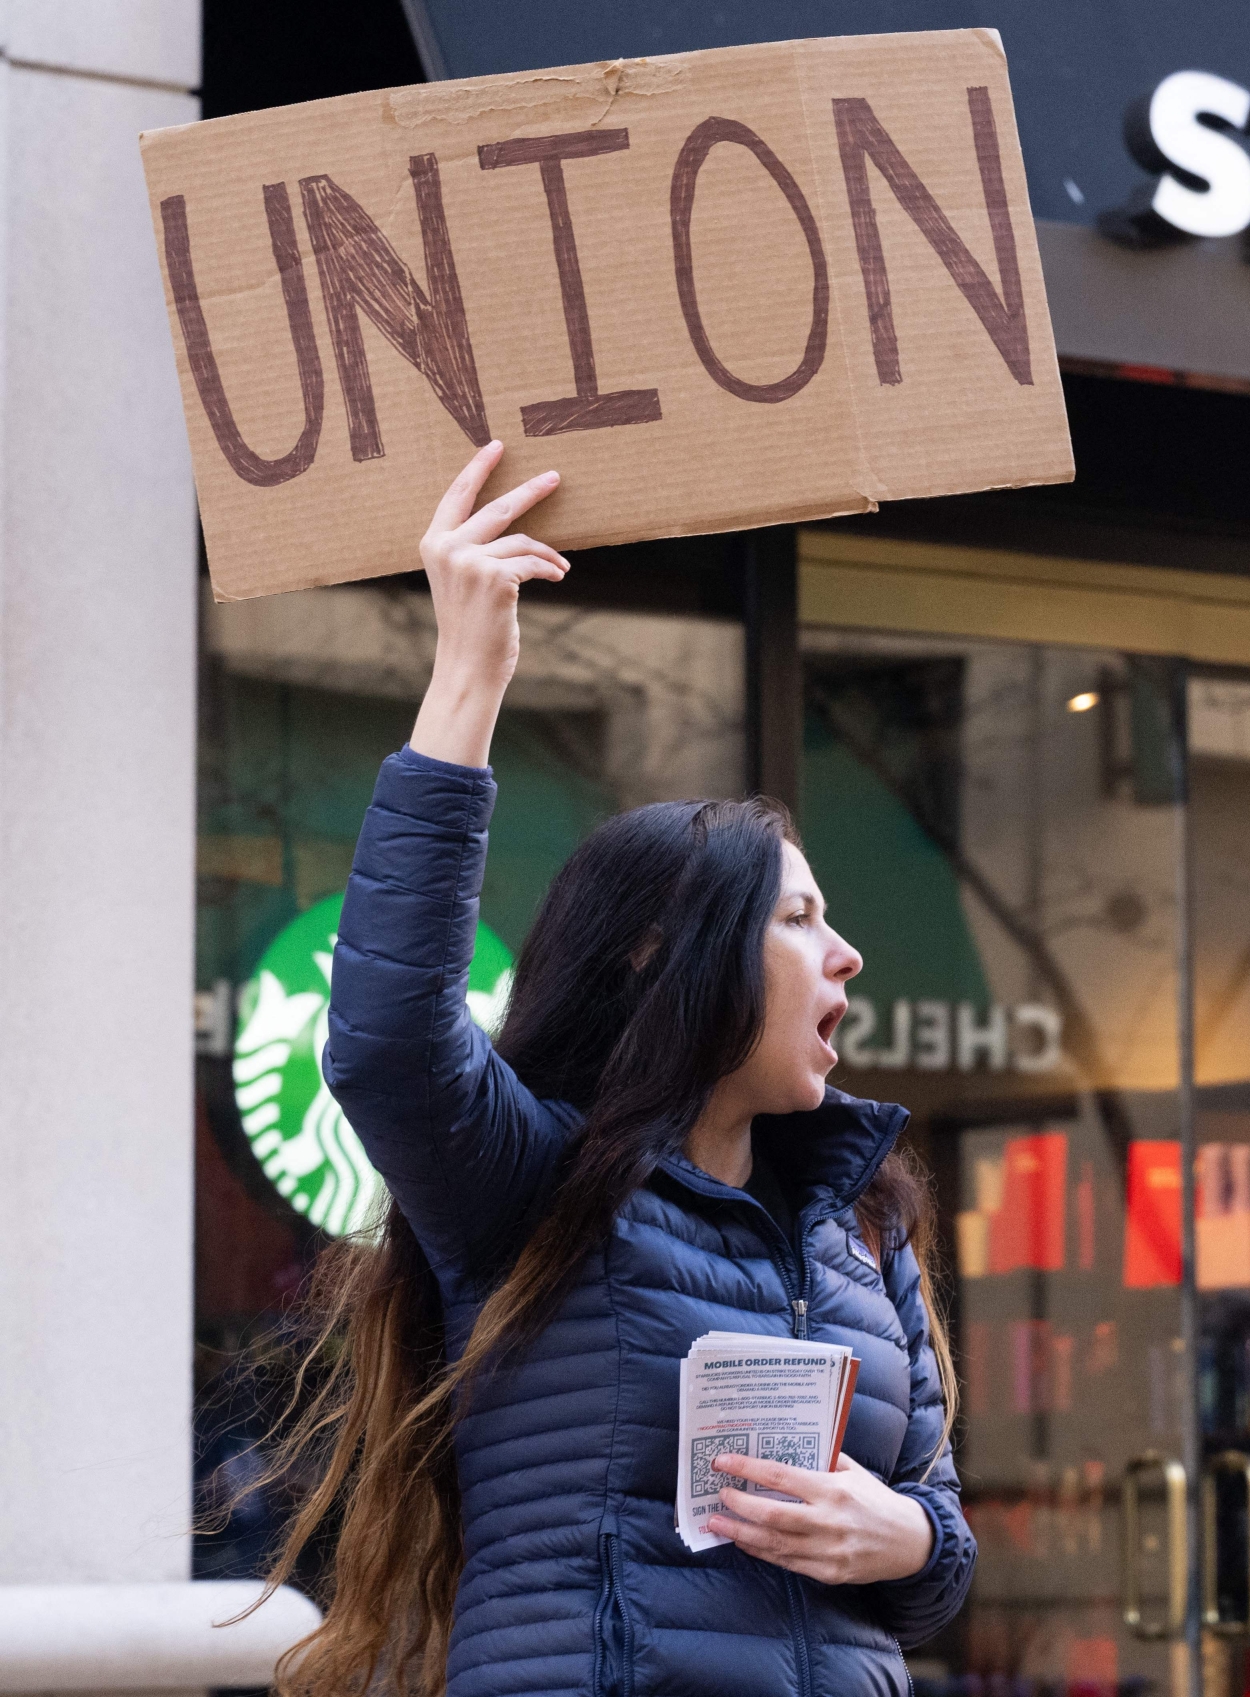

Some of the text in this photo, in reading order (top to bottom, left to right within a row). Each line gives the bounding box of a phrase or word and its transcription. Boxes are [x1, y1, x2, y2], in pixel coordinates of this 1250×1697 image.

[160, 86, 1034, 488] UNION
[704, 1358, 827, 1370] MOBILE ORDER REFUND
[692, 1505, 706, 1517] SIGN
[707, 1503, 720, 1514] THE
